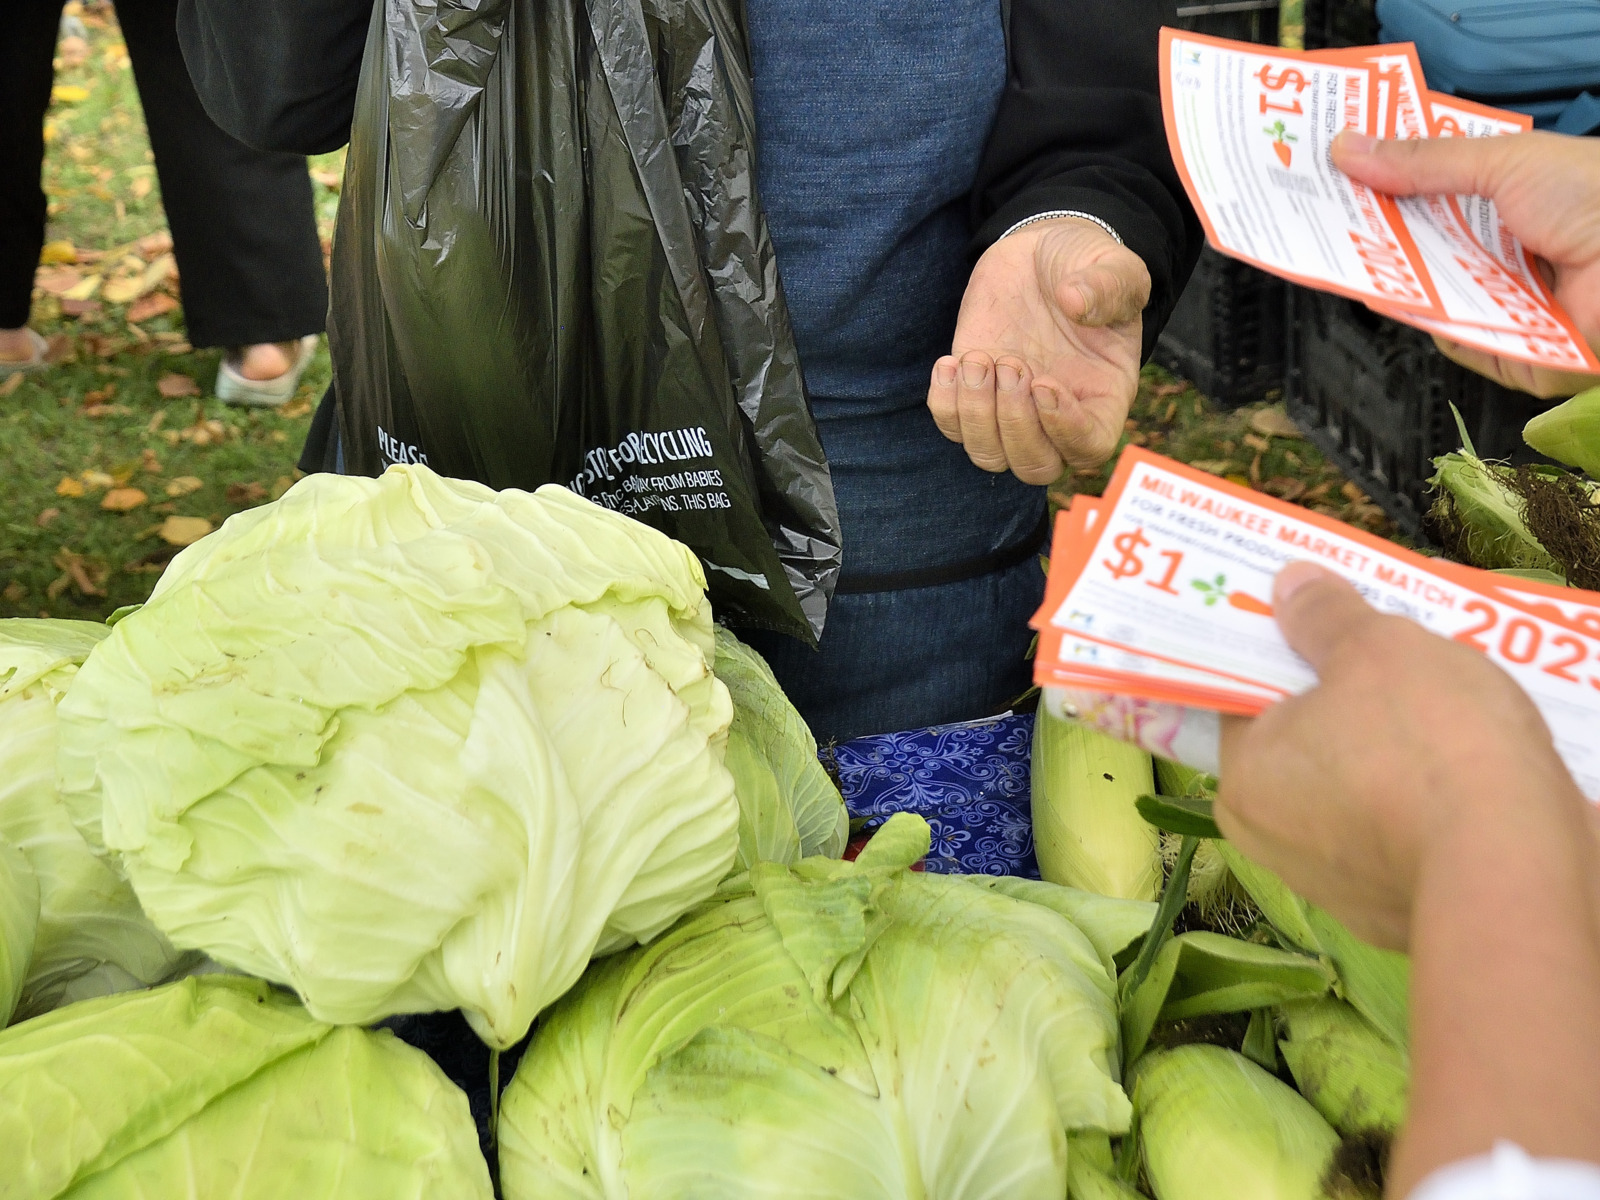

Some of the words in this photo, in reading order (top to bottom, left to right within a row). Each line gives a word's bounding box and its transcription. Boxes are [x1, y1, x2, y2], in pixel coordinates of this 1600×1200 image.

[1254, 62, 1312, 116] $1
[1347, 230, 1424, 300] 2023
[651, 473, 686, 493] FROM
[684, 469, 723, 489] BABIES
[681, 494, 707, 510] THIS
[706, 492, 731, 509] BAG
[1103, 526, 1184, 596] $1
[1131, 496, 1164, 516] FOR
[1168, 510, 1219, 537] FRESH
[1224, 530, 1297, 562] PRODUC
[1139, 474, 1273, 536] MILWAUKEE
[1276, 525, 1371, 572] MARKET
[1374, 562, 1457, 609] MATCH
[1452, 600, 1600, 691] 202
